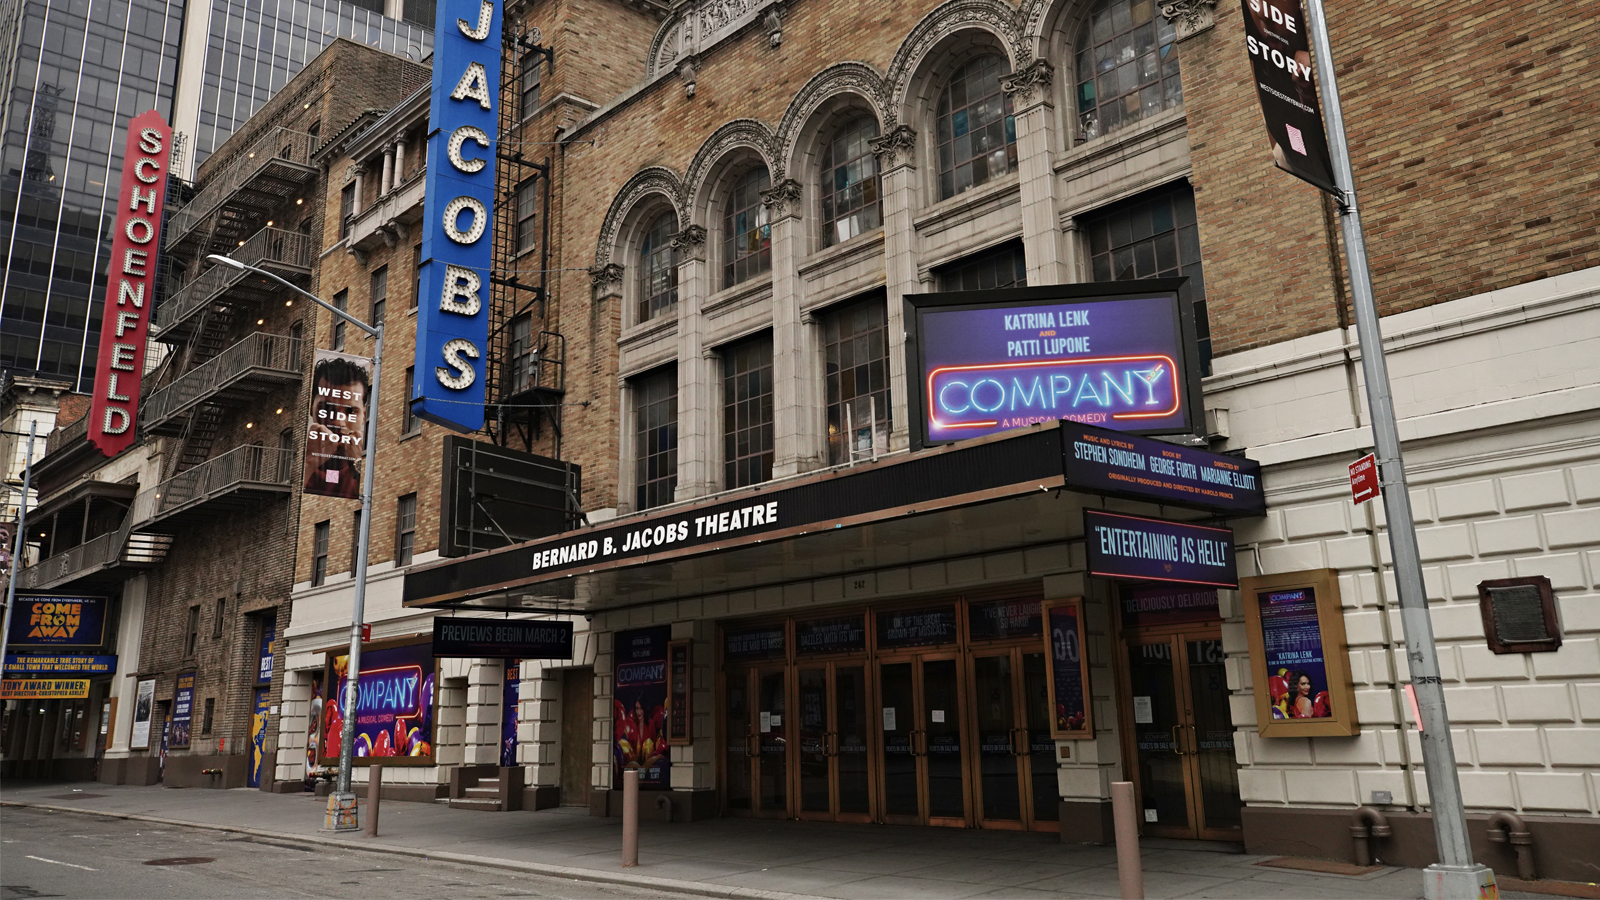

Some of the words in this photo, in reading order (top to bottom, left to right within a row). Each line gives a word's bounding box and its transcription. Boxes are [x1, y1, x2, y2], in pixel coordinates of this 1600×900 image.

[1249, 0, 1297, 34] SIDE
[1247, 35, 1311, 82] STORY
[434, 0, 493, 390] JACOBS
[101, 127, 163, 435] SCHOENFELD
[1004, 312, 1055, 330] KATRINA
[1059, 310, 1090, 327] LENK
[1007, 339, 1040, 356] PATTI
[1044, 336, 1090, 355] LUPONE
[318, 386, 362, 401] WEST
[939, 364, 1164, 412] COMPANY
[318, 409, 357, 423] SIDE
[1002, 419, 1010, 428] A
[309, 430, 362, 446] STORY
[1083, 434, 1098, 443] MUSIC
[1111, 440, 1127, 448] LYRICS
[1074, 441, 1107, 464] STEPHEN
[1108, 448, 1146, 470] SONDHEIM
[1150, 456, 1176, 476] GEORGE
[1176, 461, 1197, 480] FURTH
[1214, 461, 1233, 470] DIRECTED
[1350, 467, 1355, 475] NO
[1355, 460, 1371, 474] STANDING
[1108, 472, 1136, 483] ORIGINALLY
[1137, 477, 1162, 488] PRODUCED
[1173, 483, 1194, 493] DIRECTED
[1201, 488, 1218, 496] HAROLD
[1219, 491, 1233, 499] PRINCE
[1200, 466, 1233, 487] MARIANNE
[1233, 472, 1256, 490] ELLIOTT
[532, 540, 598, 570] BERNARD
[602, 536, 617, 556] B.
[622, 521, 688, 552] JACOBS
[695, 502, 778, 537] THEATRE
[1095, 526, 1178, 562] “ENTERTAINING
[1182, 537, 1195, 564] AS
[1197, 539, 1228, 566] HELL!”
[854, 580, 865, 589] 242
[1271, 592, 1303, 601] COMPANY
[32, 602, 82, 614] COME
[998, 605, 1017, 618] NEVER
[1019, 603, 1042, 616] LAUGHE
[30, 614, 80, 626] FROM
[905, 616, 911, 627] OF
[913, 615, 923, 626] THE
[924, 613, 941, 625] GREAT
[1000, 618, 1008, 629] SO
[28, 626, 79, 638] AWAY
[441, 625, 493, 641] PREVIEWS
[495, 626, 523, 642] BEGIN
[525, 628, 558, 643] MARCH
[560, 628, 566, 643] 2
[801, 632, 822, 646] DAZZLES
[824, 631, 838, 643] WITH
[839, 630, 848, 642] ITS
[743, 641, 749, 652] BE
[750, 639, 760, 651] MAD
[761, 639, 768, 650] TO
[261, 656, 271, 671] BEST
[507, 668, 519, 680] BEST
[619, 664, 664, 682] COMPANY
[2, 681, 23, 690] TONY
[23, 681, 52, 690] AWARD
[54, 681, 86, 690] WINNER!
